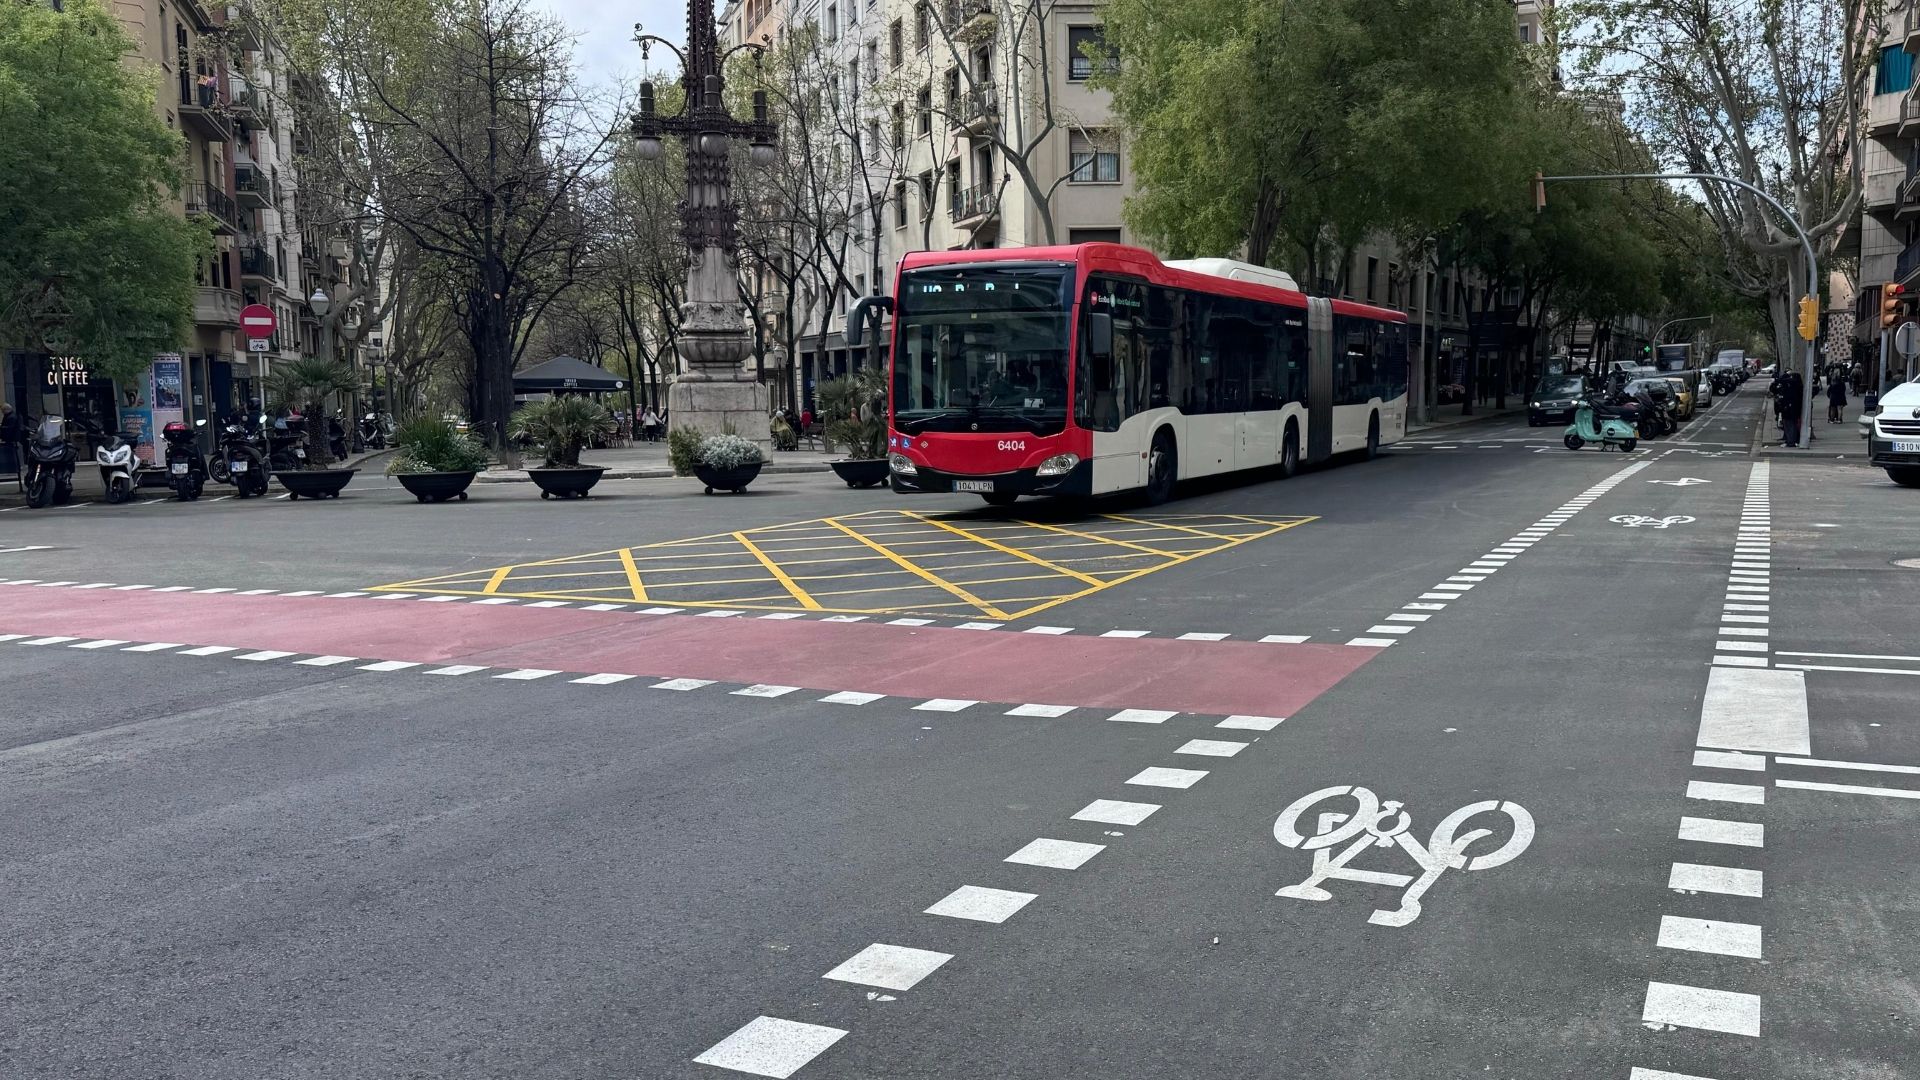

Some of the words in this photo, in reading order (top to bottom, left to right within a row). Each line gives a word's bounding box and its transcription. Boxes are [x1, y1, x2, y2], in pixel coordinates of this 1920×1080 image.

[50, 356, 84, 370] TRIGO
[997, 440, 1026, 451] 6404
[1897, 442, 1914, 450] 5810
[959, 482, 976, 491] 1041
[978, 482, 993, 491] LPN
